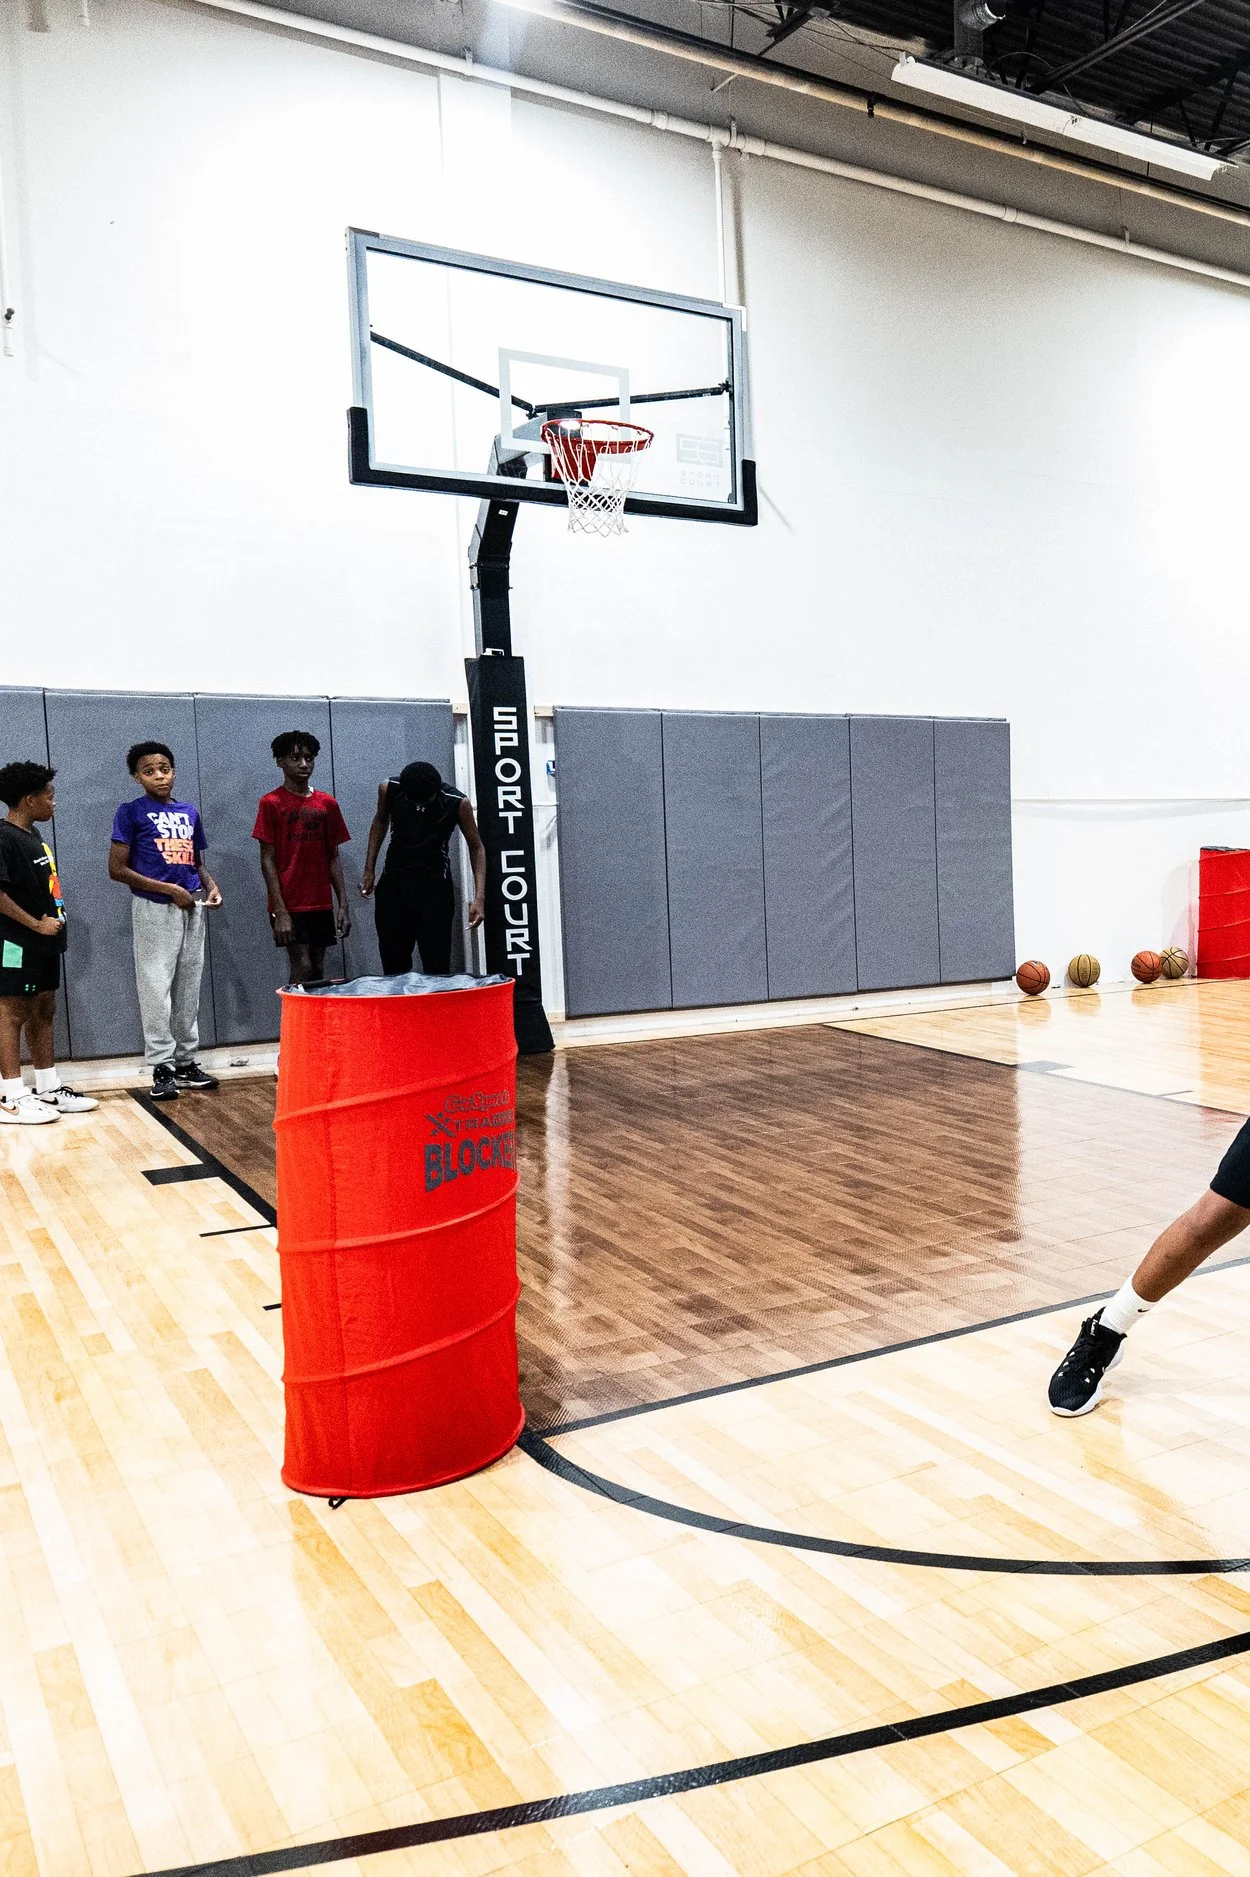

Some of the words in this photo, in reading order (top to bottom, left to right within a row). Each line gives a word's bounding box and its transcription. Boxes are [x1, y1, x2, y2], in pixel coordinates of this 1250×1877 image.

[493, 707, 525, 834] SPORT
[501, 850, 533, 976] COURT
[424, 1129, 517, 1193] BLOCKE
